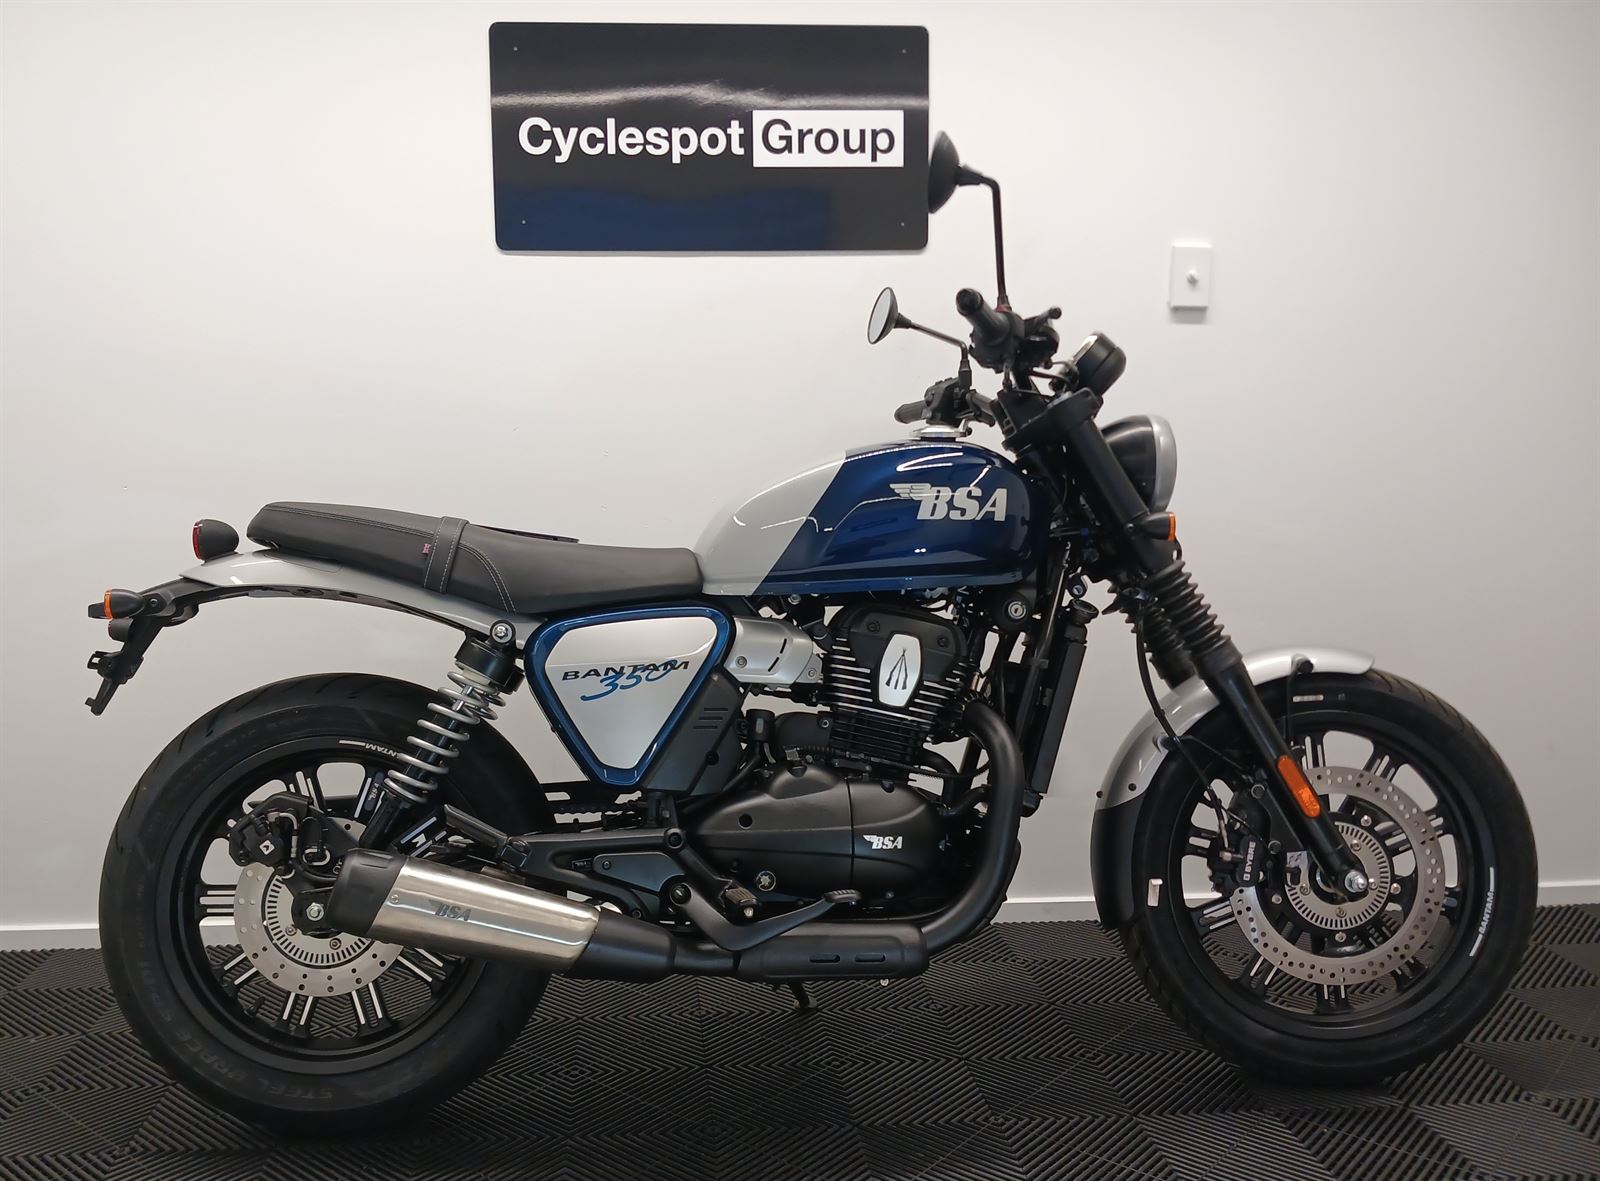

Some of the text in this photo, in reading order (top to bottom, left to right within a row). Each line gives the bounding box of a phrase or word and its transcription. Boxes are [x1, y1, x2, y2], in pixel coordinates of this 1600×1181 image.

[518, 117, 896, 163] Cyclespot Group
[914, 486, 1008, 521] BSA
[561, 660, 690, 681] BANTAM
[580, 659, 678, 702] 350
[870, 835, 903, 850] BSA
[1478, 891, 1495, 934] BANTAM
